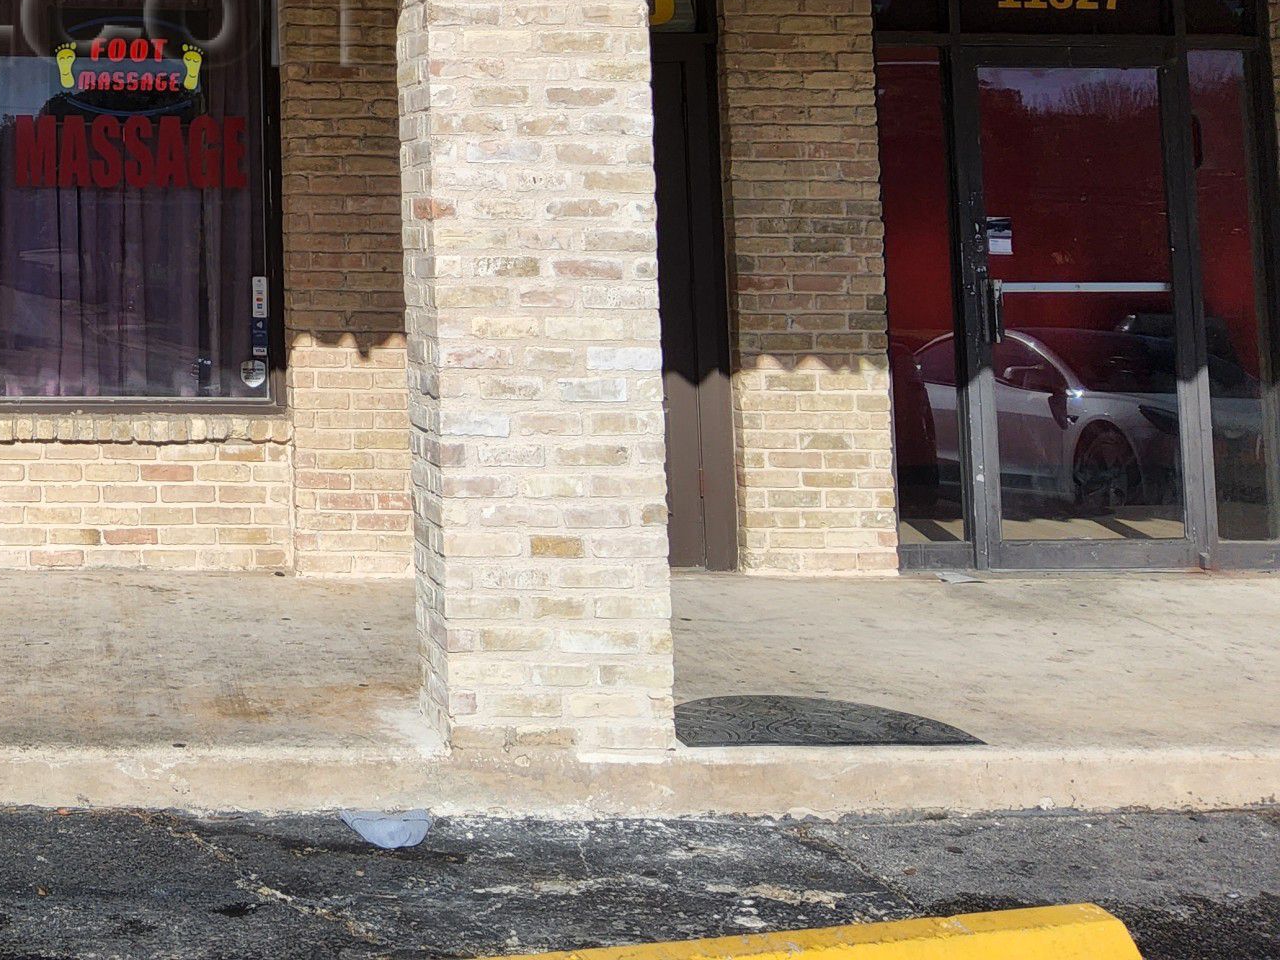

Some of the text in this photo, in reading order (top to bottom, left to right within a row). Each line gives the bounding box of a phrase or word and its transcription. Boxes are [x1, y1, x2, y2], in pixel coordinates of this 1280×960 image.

[89, 38, 169, 63] FOOT
[77, 70, 181, 92] MASSAGE
[15, 114, 248, 189] MASSAGE
